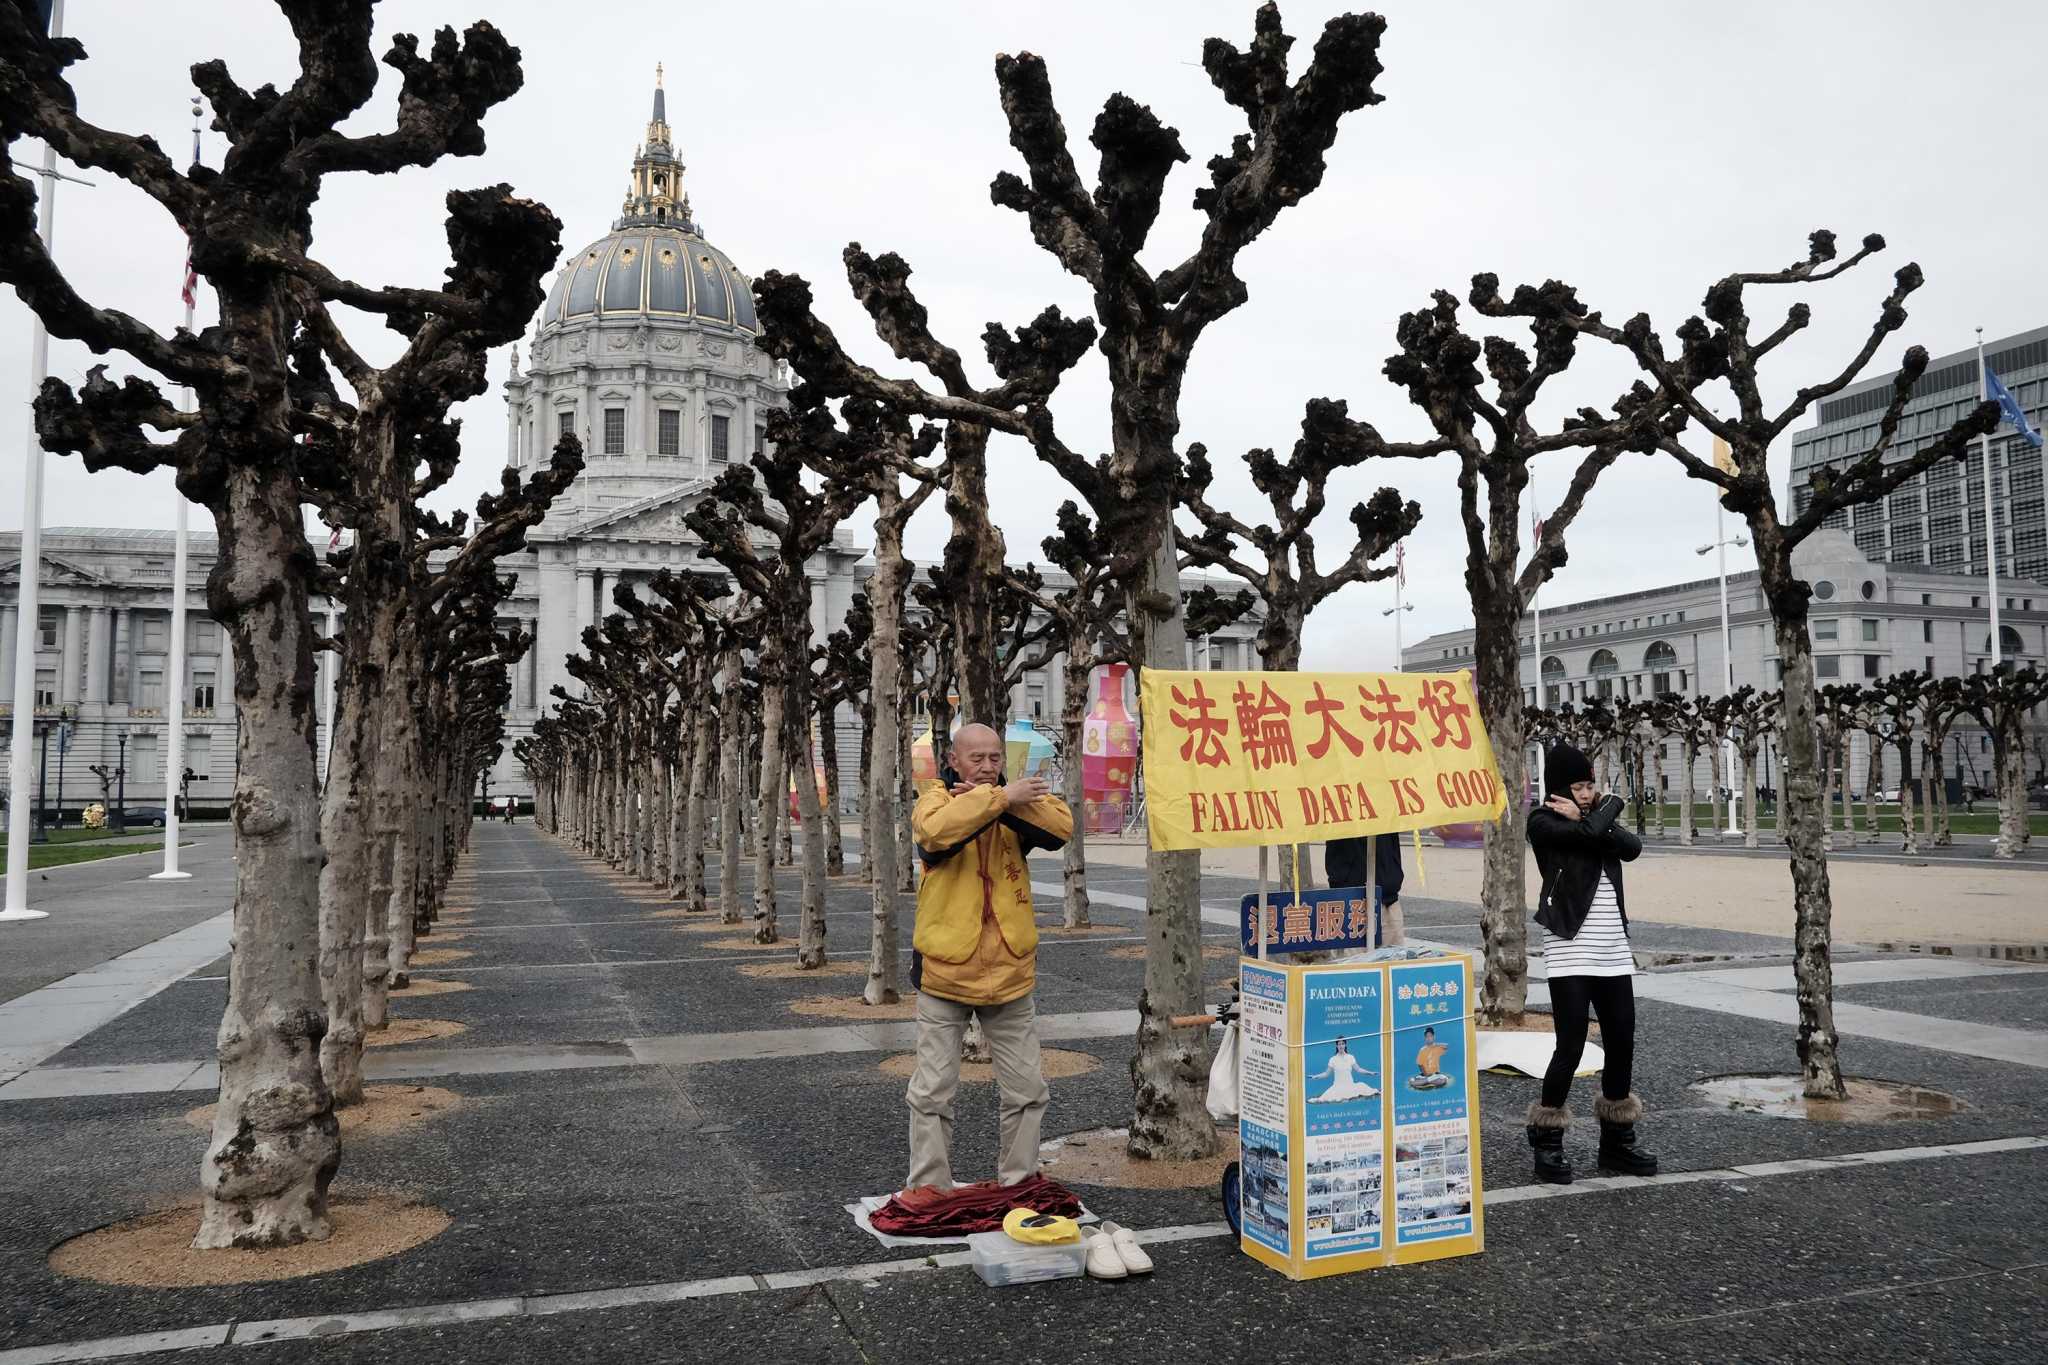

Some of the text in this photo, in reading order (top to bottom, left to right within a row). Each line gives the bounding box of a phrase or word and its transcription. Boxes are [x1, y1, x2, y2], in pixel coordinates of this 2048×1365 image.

[1169, 678, 1472, 771] 法輪大法好
[1188, 789, 1284, 833] FALUN
[1297, 781, 1378, 826] DAFA
[1389, 776, 1426, 817] IS
[1309, 985, 1377, 1000] FALUN DAFA
